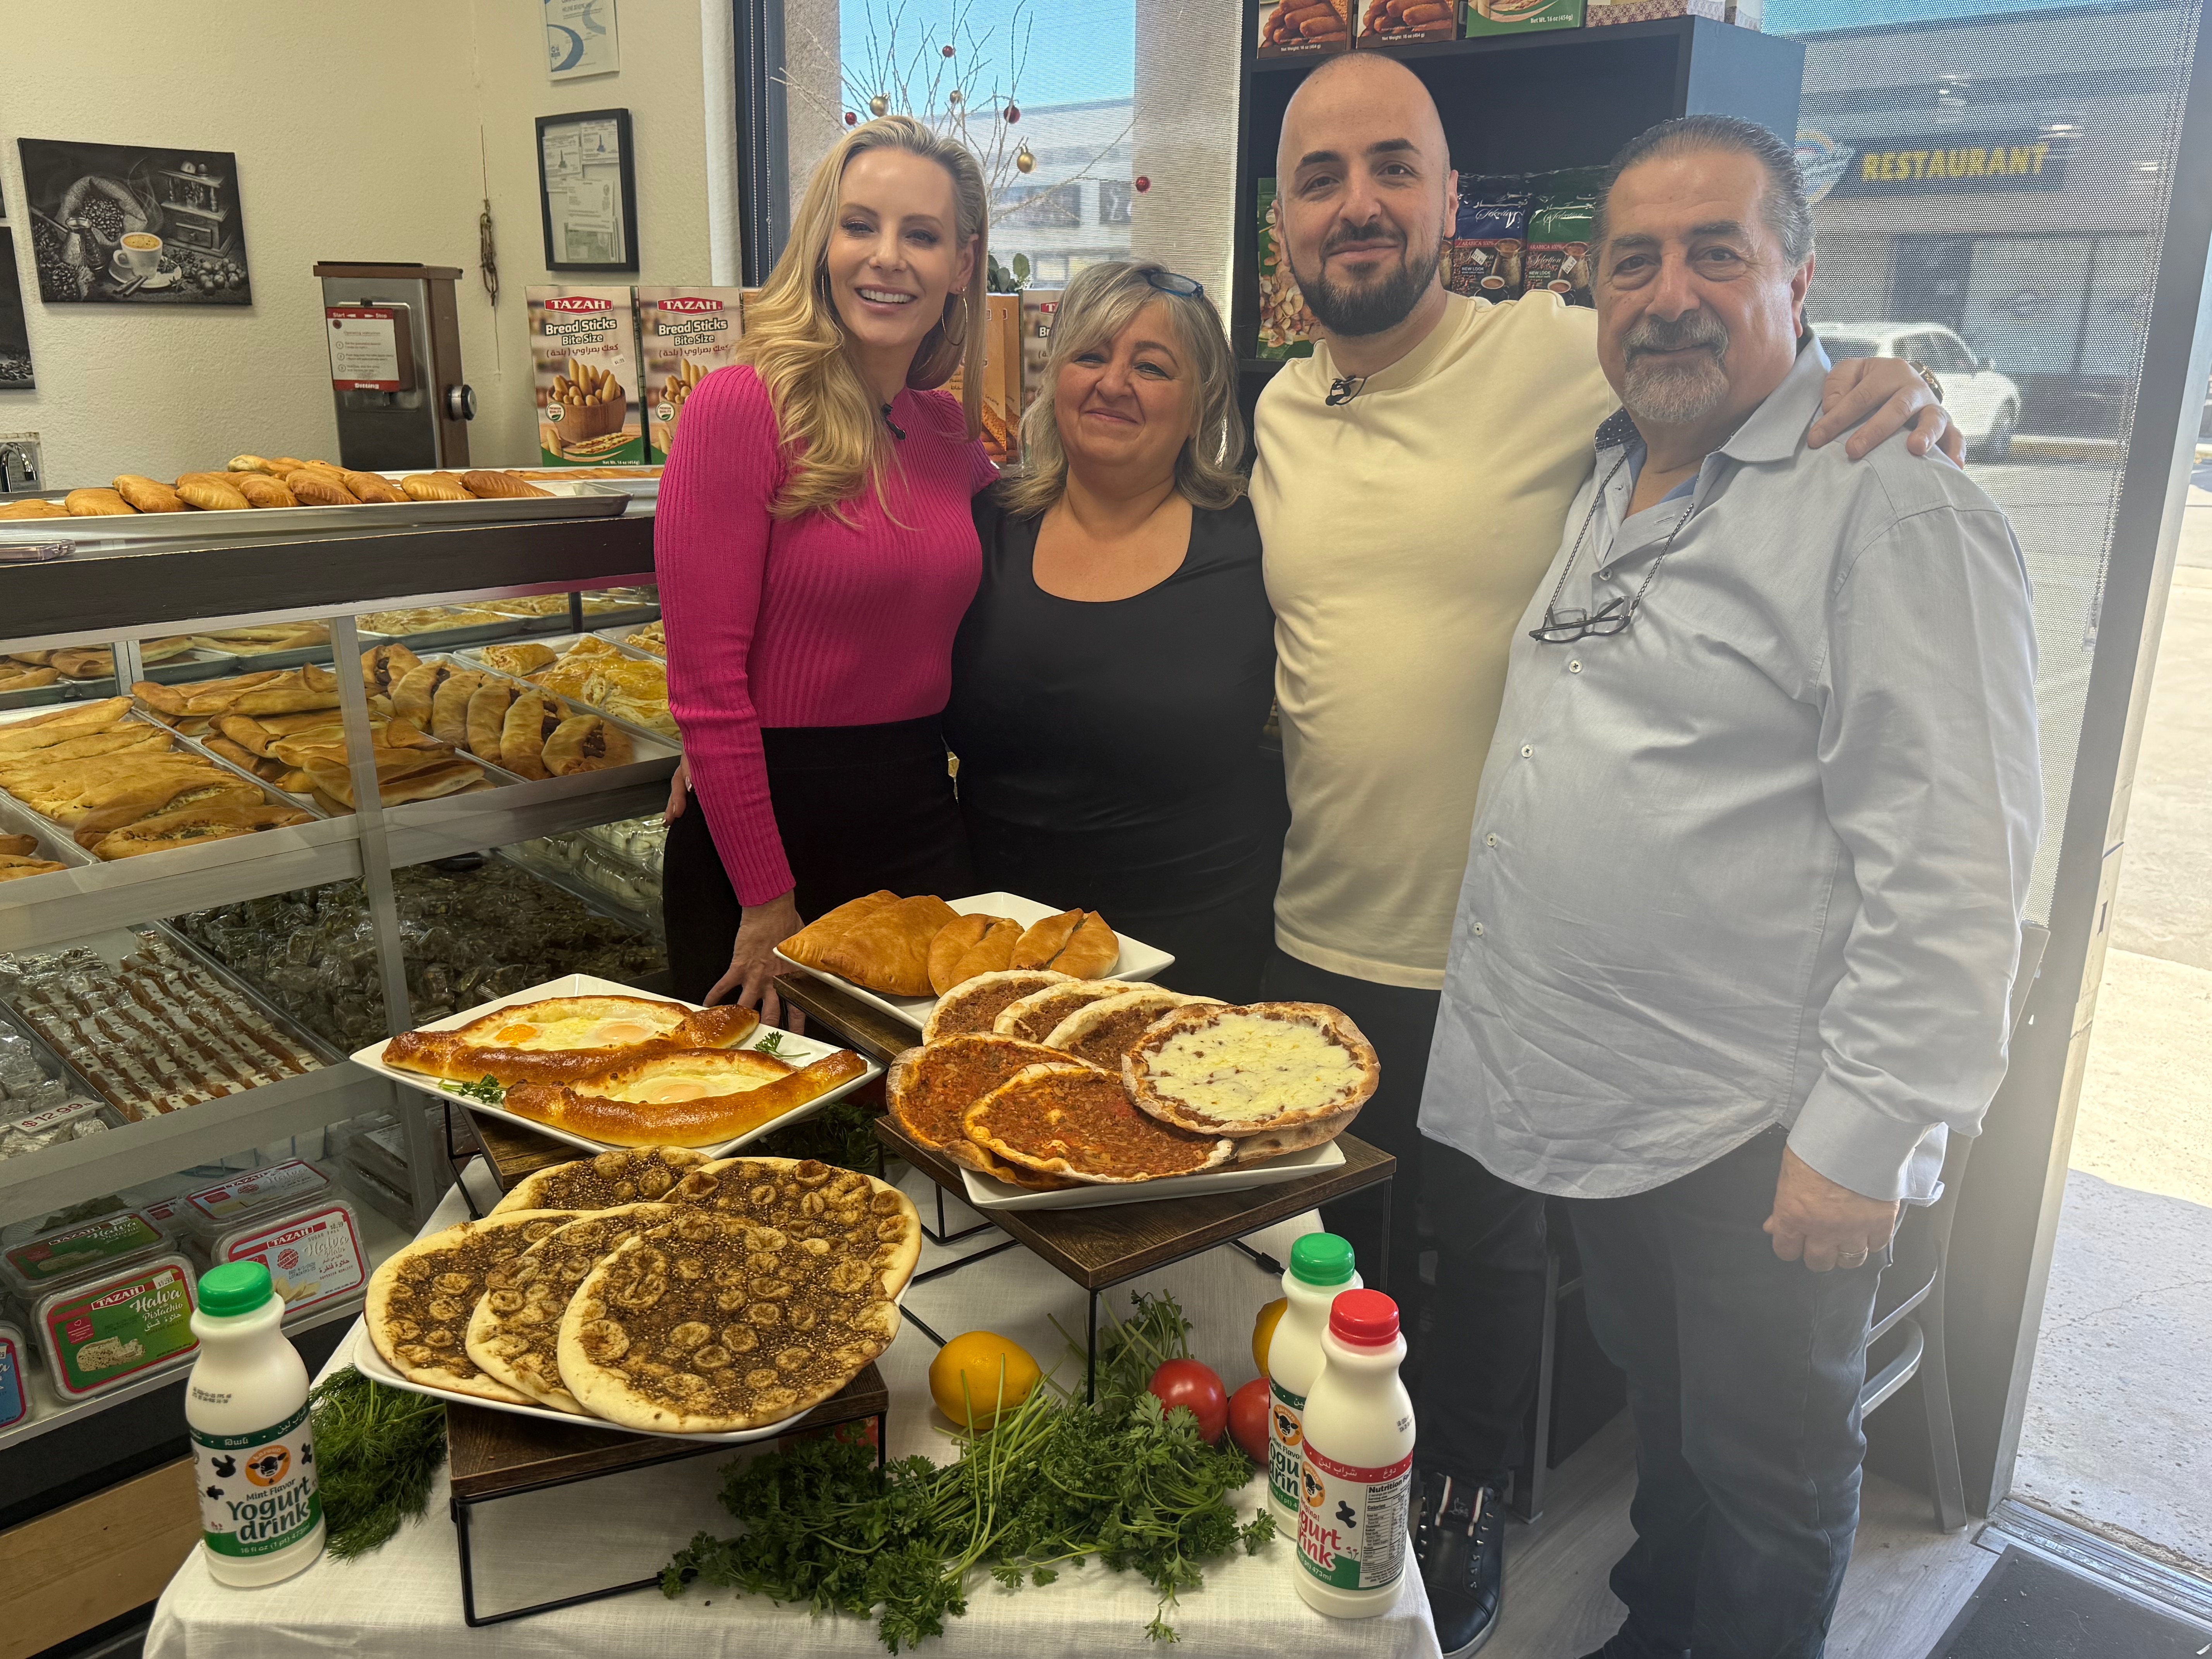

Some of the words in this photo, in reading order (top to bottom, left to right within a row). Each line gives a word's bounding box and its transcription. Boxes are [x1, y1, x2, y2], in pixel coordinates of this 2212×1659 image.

[1862, 142, 2049, 182] RESTAURANT
[551, 300, 605, 309] TAZAH
[664, 301, 717, 310] TAZAH
[545, 321, 579, 335] Bread
[582, 318, 617, 330] Sticks
[659, 321, 691, 335] Bread
[694, 318, 727, 331] Sticks
[562, 336, 582, 345] Bite
[583, 334, 603, 343] Size
[675, 337, 694, 345] Bite
[695, 334, 714, 343] Size
[572, 347, 600, 356] بصراوي
[602, 344, 618, 352] كعك
[685, 347, 711, 356] بصراوي
[22, 1104, 83, 1127] $12.99
[330, 1221, 343, 1230] $8.99
[271, 1228, 309, 1246] TAZAH
[308, 1233, 324, 1242] SUGAR
[335, 1259, 350, 1268] حلاوة
[97, 1287, 140, 1307] TAZAH
[130, 1290, 183, 1312] Halva
[143, 1303, 183, 1321] Pistachio
[165, 1313, 182, 1322] حلاوة
[253, 1448, 281, 1460] karoun
[1283, 1446, 1302, 1460] Flavo
[1319, 1458, 1331, 1470] لبن
[1269, 1459, 1299, 1497] drin
[1333, 1467, 1357, 1477] شراب
[1383, 1468, 1396, 1479] دوغ
[246, 1491, 268, 1501] Mint
[270, 1479, 296, 1495] Flavor
[1369, 1479, 1402, 1493] Nutrition
[226, 1476, 311, 1520] Yogurt
[240, 1502, 309, 1541] drink
[292, 1522, 310, 1539] 473ml
[1297, 1527, 1332, 1568] rink
[1312, 1566, 1331, 1581] 473ml
